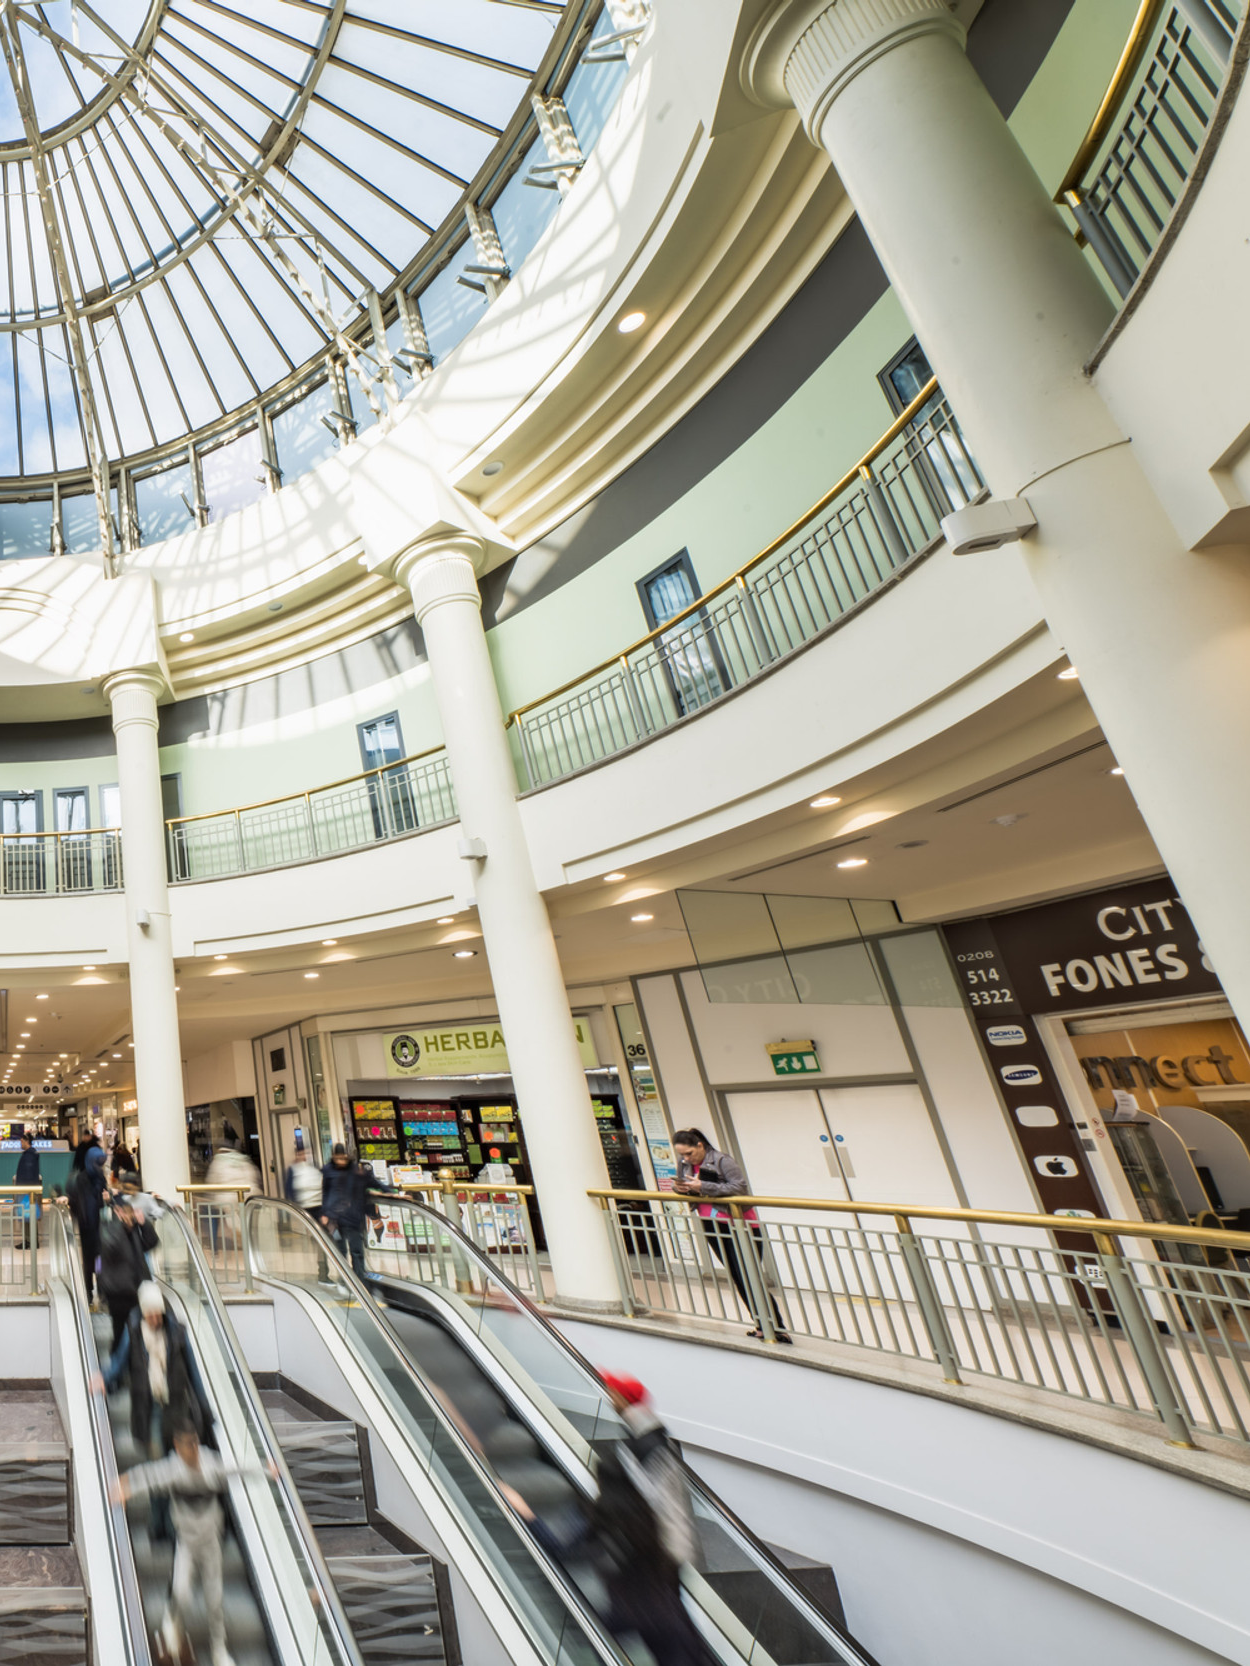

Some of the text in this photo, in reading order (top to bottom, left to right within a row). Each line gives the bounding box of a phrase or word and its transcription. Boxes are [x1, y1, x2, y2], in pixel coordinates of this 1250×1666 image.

[957, 950, 994, 963] 0208
[967, 967, 1000, 985] 514
[1040, 943, 1188, 997] FONES
[969, 988, 1014, 1006] 3322
[627, 1043, 646, 1057] 36
[1080, 1045, 1246, 1090] nnect
